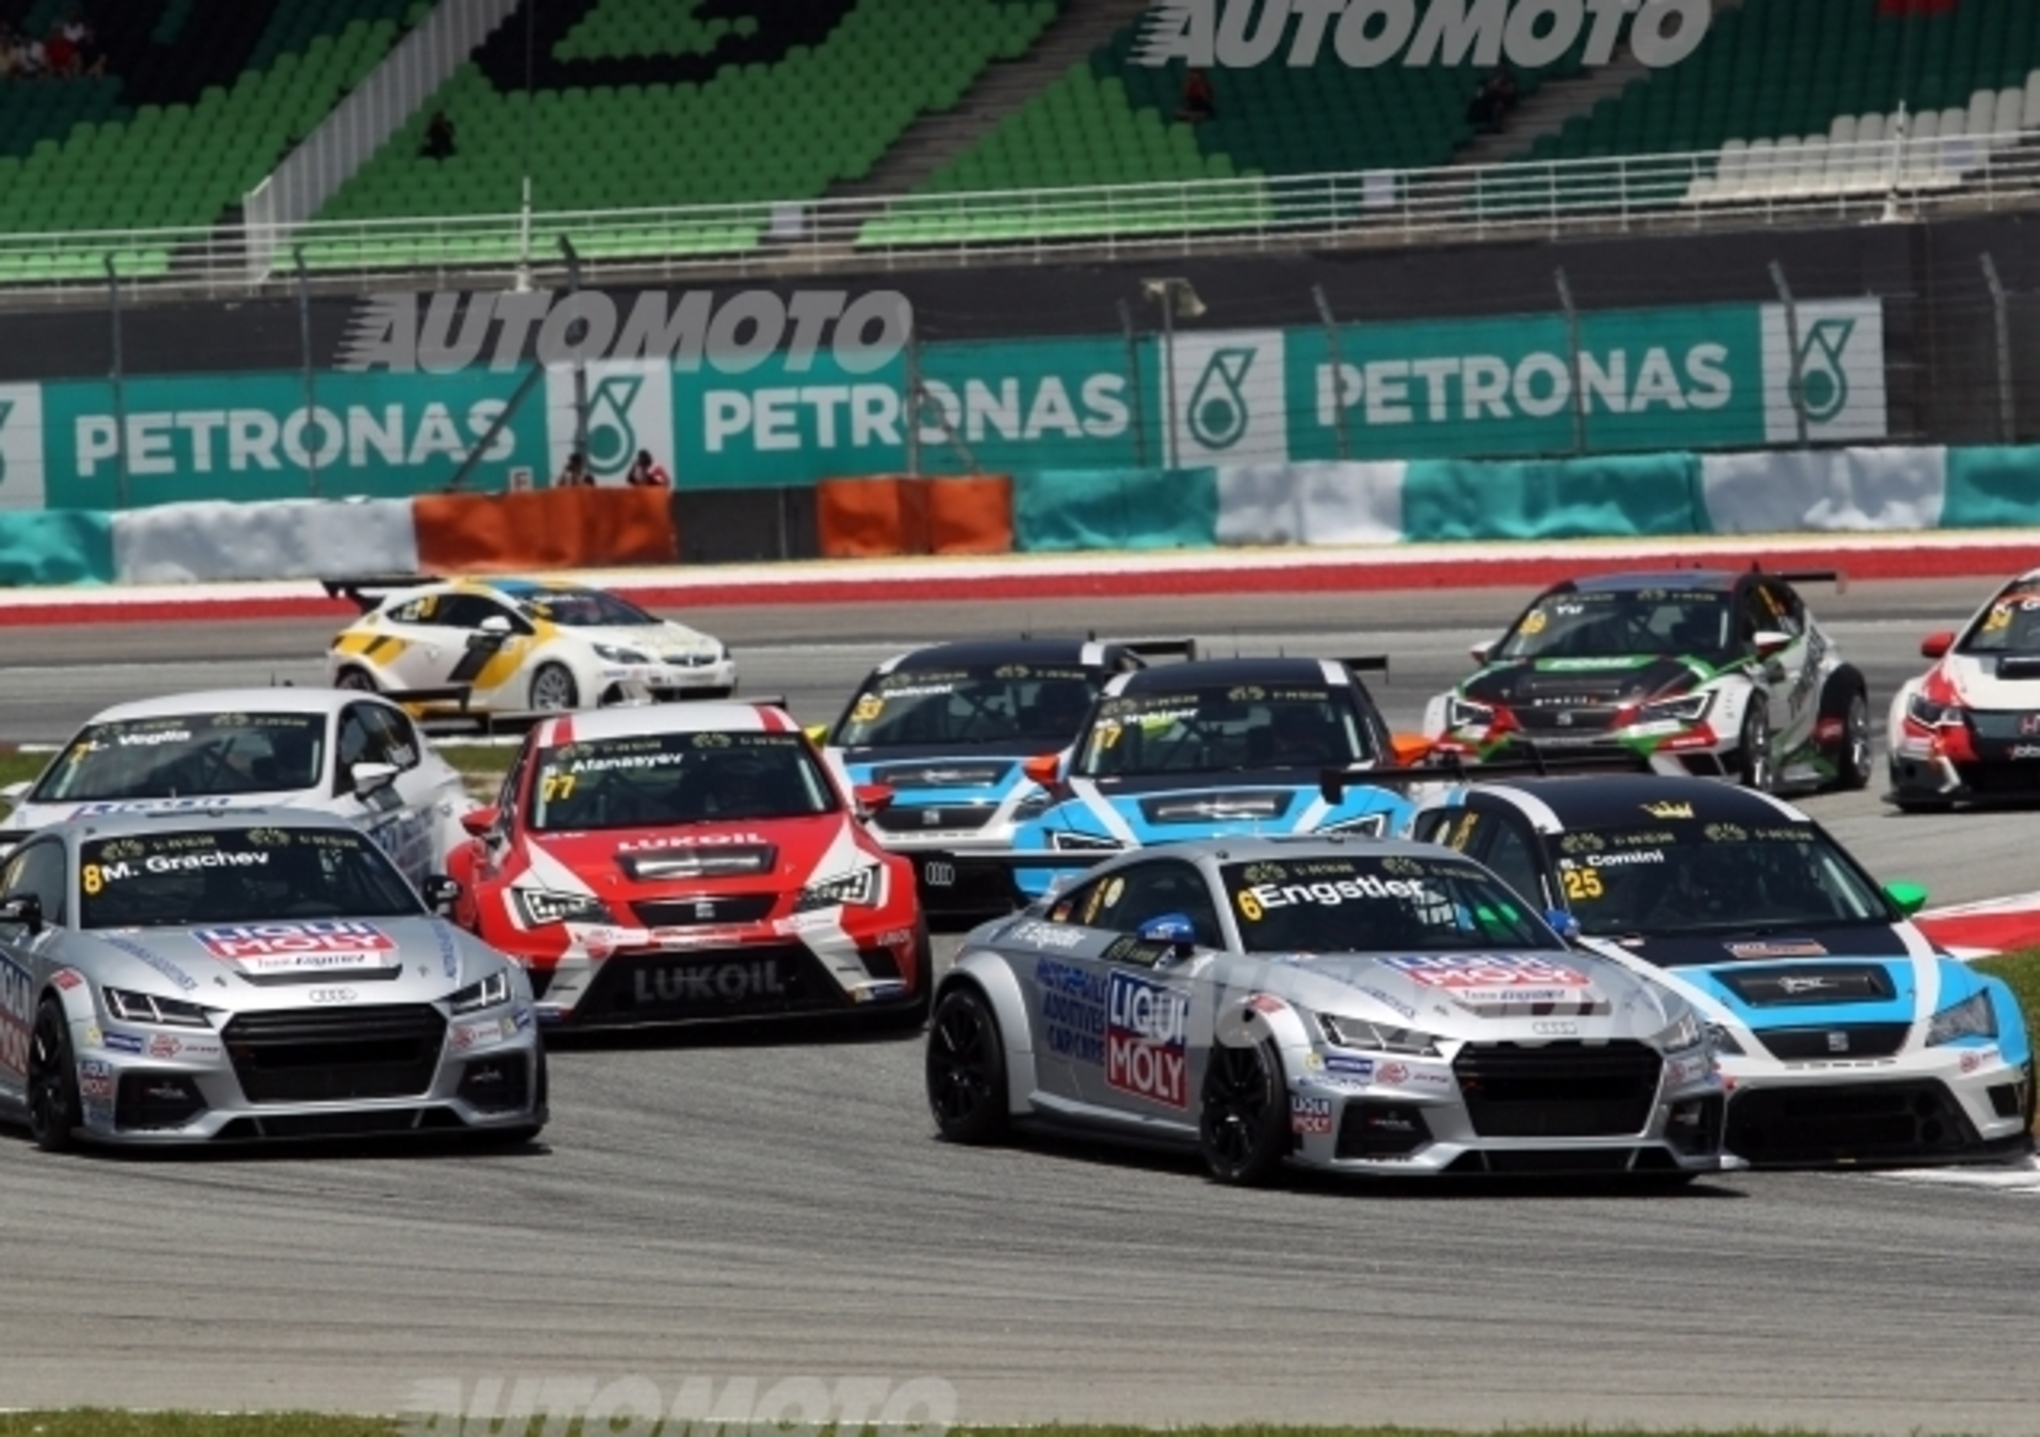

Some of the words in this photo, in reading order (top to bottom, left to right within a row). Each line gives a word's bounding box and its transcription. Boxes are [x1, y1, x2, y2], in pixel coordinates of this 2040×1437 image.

[1316, 343, 1733, 427] PETRONAS
[704, 372, 1131, 453] PETRONAS
[74, 398, 517, 478] PETRONAS
[618, 832, 767, 851] LUKOIL
[83, 864, 102, 895] 8
[102, 863, 140, 882] M.
[146, 850, 269, 873] Grachev
[1563, 868, 1604, 899] 25
[1237, 889, 1263, 922] 6
[1251, 873, 1425, 911] Engstler
[203, 921, 372, 940] LIQUI
[218, 933, 381, 957] MOLY
[633, 959, 785, 1001] LUKOIL
[1110, 978, 1189, 1045] LIQUI
[1109, 1035, 1184, 1100] MOLY
